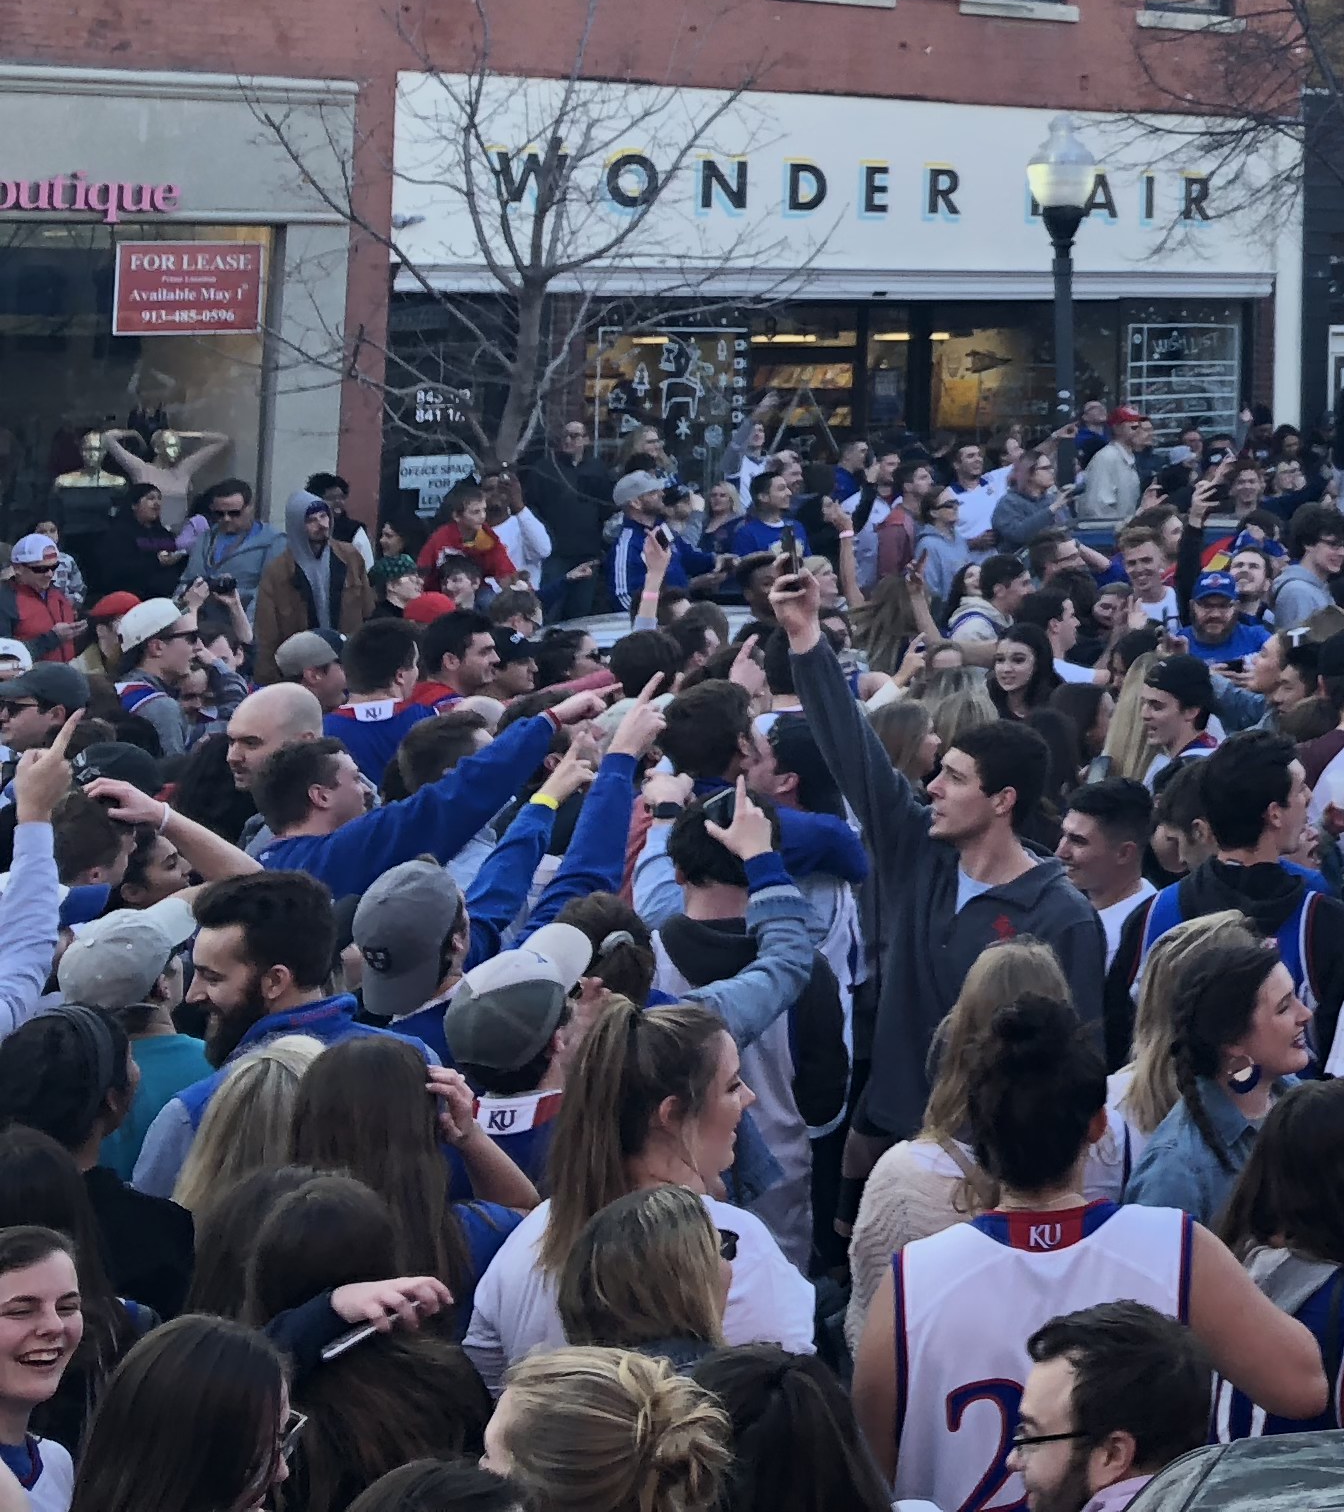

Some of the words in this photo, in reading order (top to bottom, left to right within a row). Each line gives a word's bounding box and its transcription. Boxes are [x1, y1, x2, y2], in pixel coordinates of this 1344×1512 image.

[491, 148, 961, 216] WONDER
[0, 170, 182, 223] outique
[130, 254, 176, 271] FOR
[182, 254, 252, 271] LEASE
[129, 287, 196, 302] Available
[200, 288, 231, 303] May
[440, 464, 474, 475] SPAC
[487, 1110, 517, 1131] KU
[1029, 1223, 1062, 1249] KU
